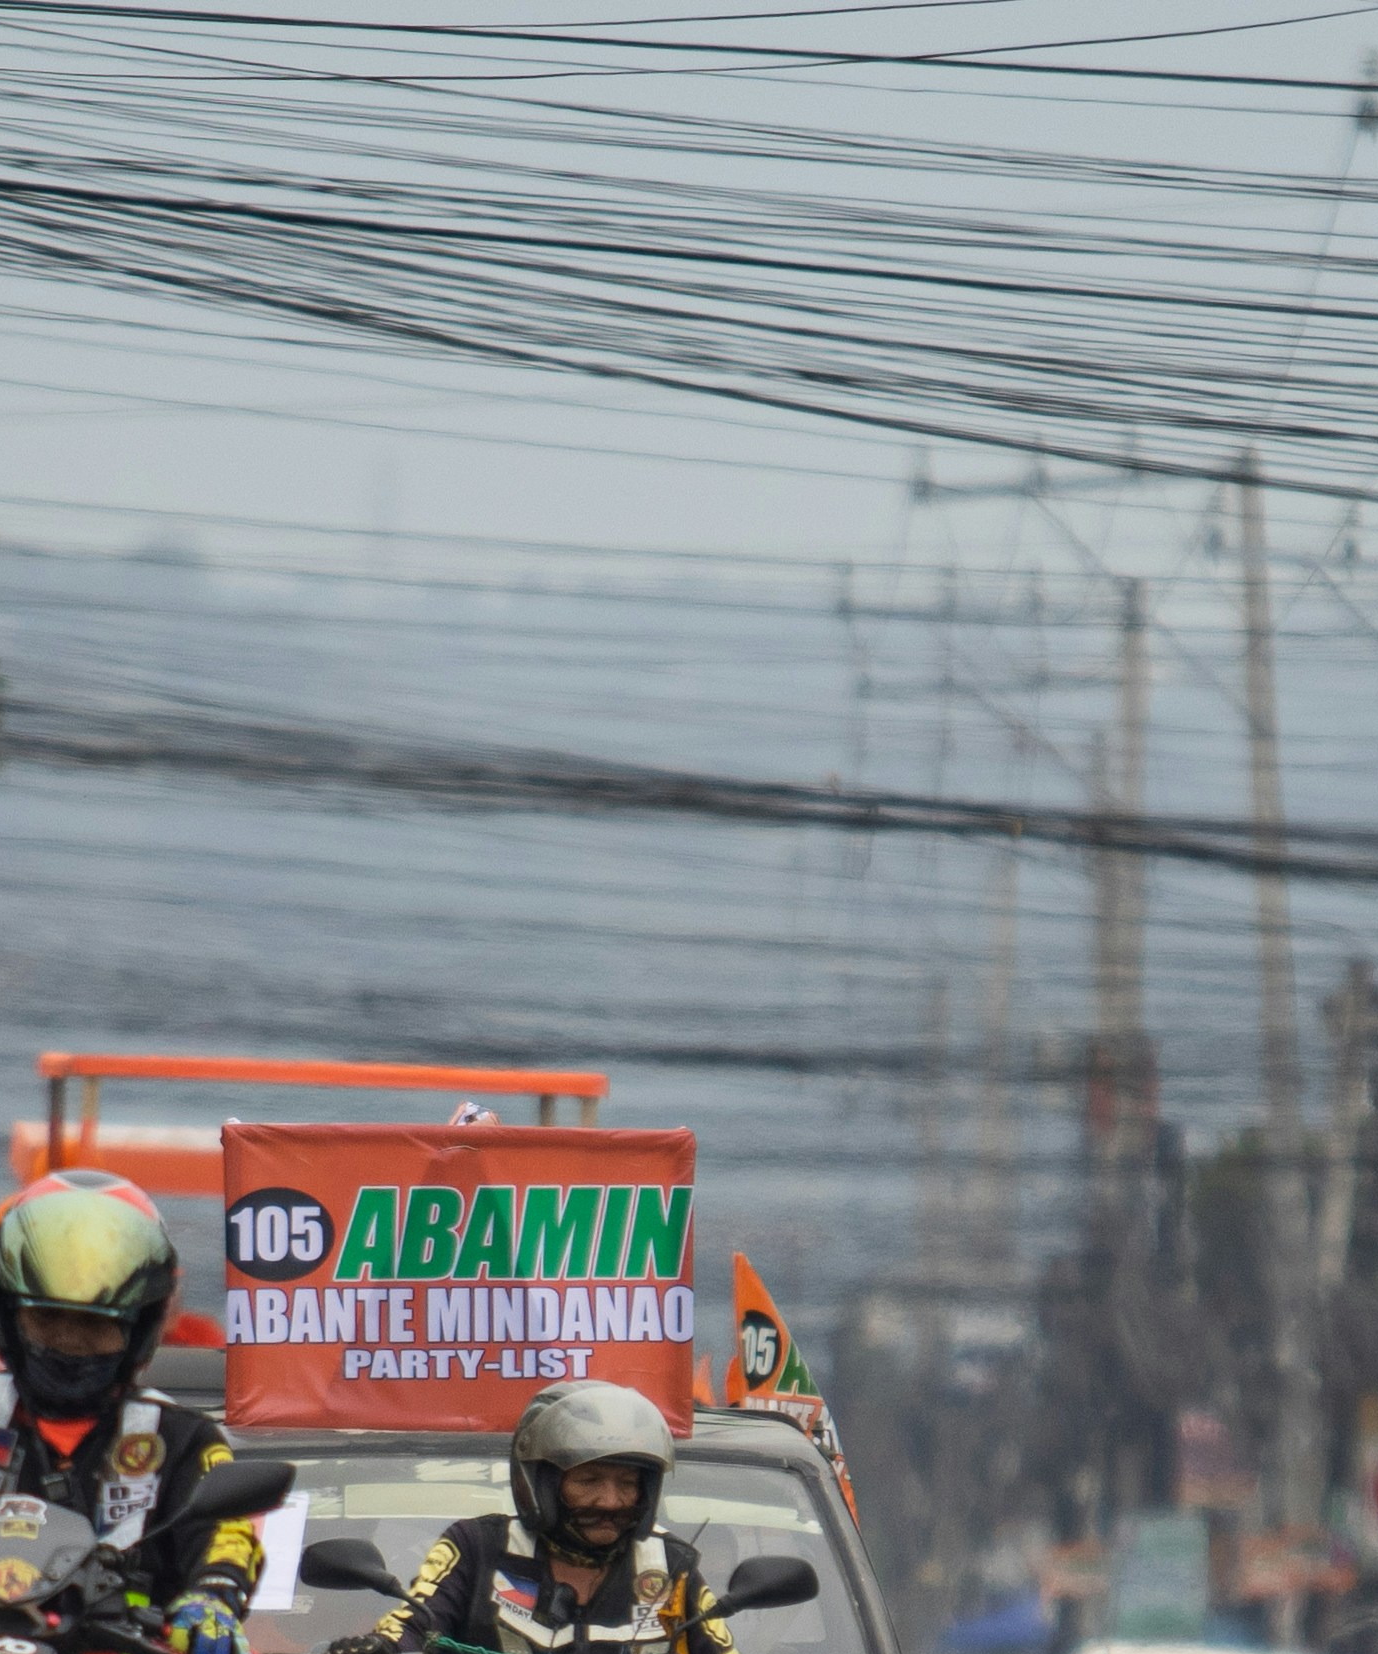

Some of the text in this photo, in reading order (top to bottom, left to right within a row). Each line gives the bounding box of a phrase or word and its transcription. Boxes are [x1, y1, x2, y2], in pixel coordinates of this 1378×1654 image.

[230, 1185, 693, 1282] 105 ABAMIN
[226, 1286, 694, 1343] ABANTE MINDANAO
[344, 1347, 593, 1379] PARTY-LIST
